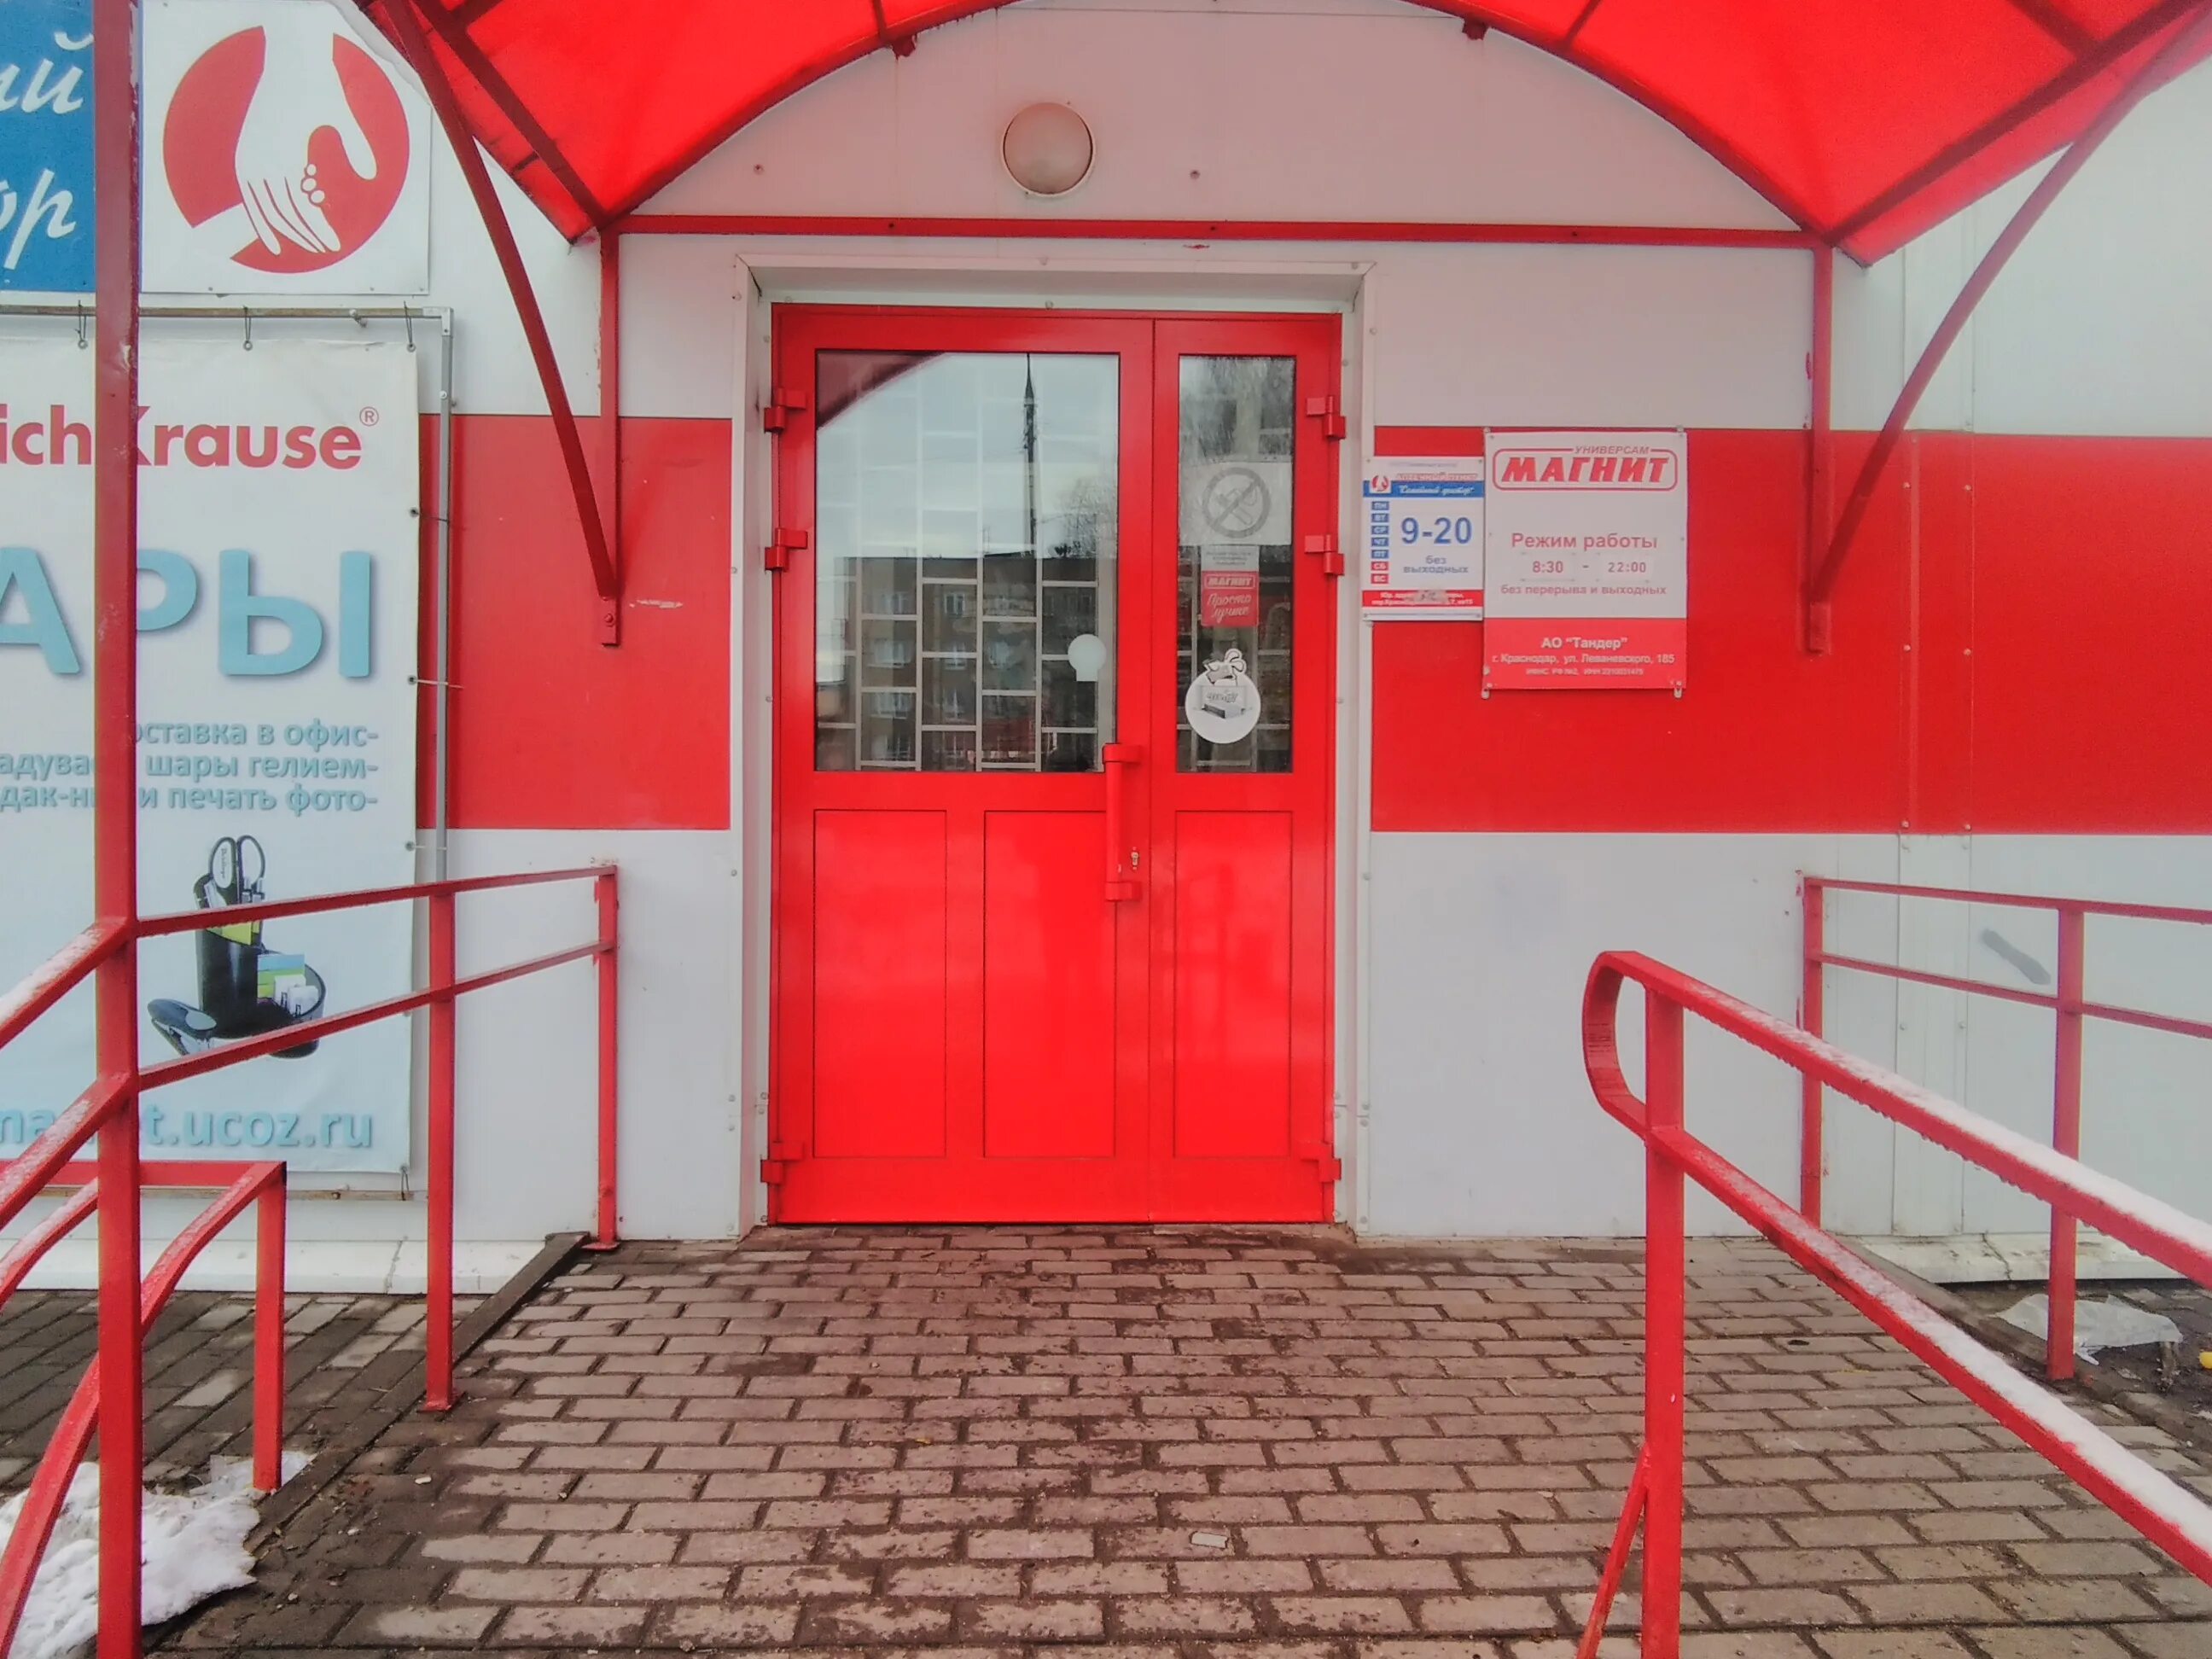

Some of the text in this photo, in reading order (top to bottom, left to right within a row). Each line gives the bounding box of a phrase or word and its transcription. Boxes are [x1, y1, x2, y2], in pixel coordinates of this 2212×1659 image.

[1575, 445, 1649, 455] УНИВЕРСАМ
[1501, 457, 1669, 483] МАГНИТ
[1400, 517, 1472, 544] 9-20
[1511, 533, 1657, 551] Режим работы
[1425, 556, 1447, 565] без
[1533, 561, 1564, 574] 8:30
[1608, 562, 1646, 573] 22:00
[1500, 584, 1667, 597] без перерыва и выходных
[1540, 637, 1563, 649] АО
[136, 719, 378, 751] ставка в офис-
[0, 753, 95, 781] адува
[146, 757, 239, 782] шары
[170, 788, 277, 810] печать
[285, 783, 378, 817] фото-
